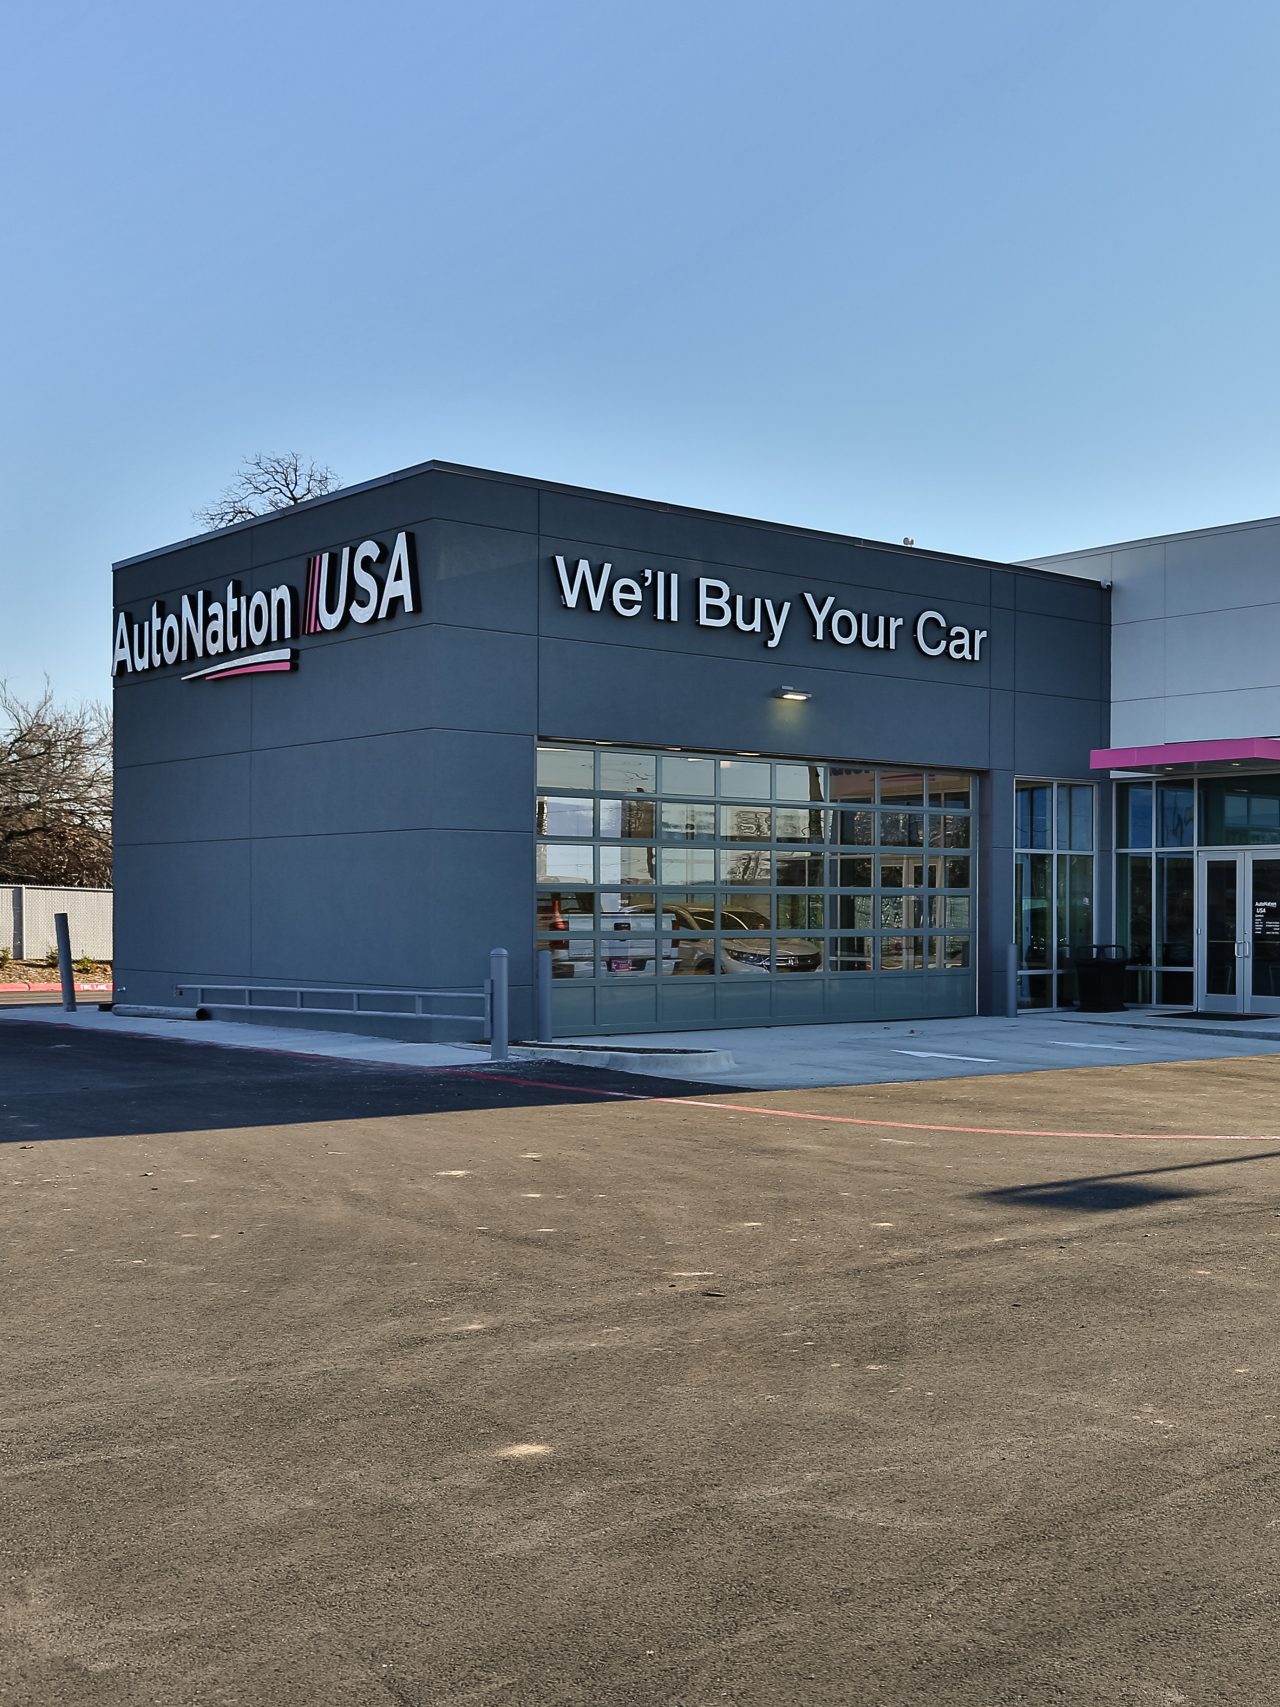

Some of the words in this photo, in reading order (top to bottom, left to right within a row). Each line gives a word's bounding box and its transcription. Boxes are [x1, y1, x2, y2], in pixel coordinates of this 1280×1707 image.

[111, 580, 293, 676] AutoNation
[318, 531, 417, 631] USA
[698, 577, 791, 648] Buy
[803, 592, 904, 650] Your
[915, 610, 989, 661] Car
